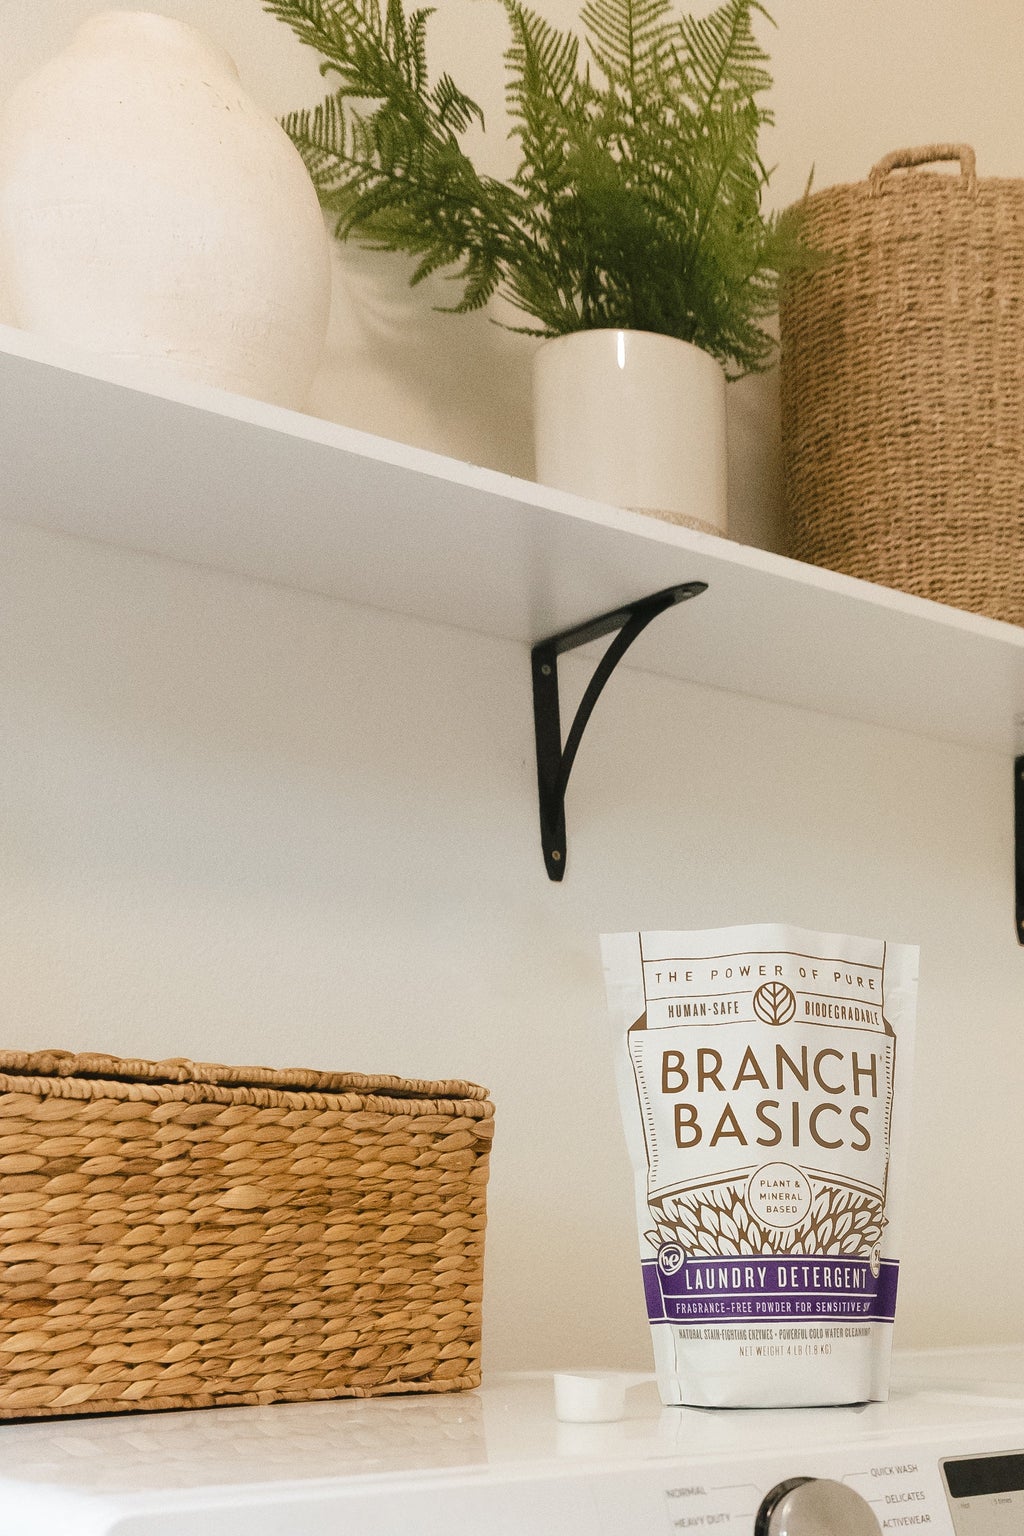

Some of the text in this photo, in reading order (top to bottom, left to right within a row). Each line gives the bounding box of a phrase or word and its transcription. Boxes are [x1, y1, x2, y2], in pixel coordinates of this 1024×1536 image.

[655, 965, 875, 991] THE POWER OF PURE
[668, 1001, 739, 1018] HUMAN-SAFE
[805, 1001, 880, 1026] BIODEGRADABLE
[661, 1044, 878, 1098] BRANCH
[674, 1100, 871, 1151] BASICS
[760, 1180, 790, 1188] PLANT
[760, 1193, 803, 1201] MINERAL
[685, 1266, 867, 1290] LAUNDRY DETERGENT
[676, 1302, 752, 1314] FRAGRANCE-FREE
[756, 1302, 792, 1313] POWDER
[795, 1302, 812, 1312] FOR
[816, 1302, 862, 1312] SENSITIVE
[679, 1329, 703, 1340] NATURAL
[779, 1329, 808, 1340] POWERFUL
[809, 1328, 823, 1339] COLD
[825, 1328, 843, 1338] WATER
[740, 1346, 753, 1356] NET
[756, 1345, 784, 1356] WEIGHT
[794, 1345, 803, 1355] LB
[871, 1464, 918, 1477] QUICK WASH
[885, 1491, 926, 1504] DELICATES
[706, 1513, 730, 1525] DUTY
[883, 1514, 931, 1528] ACTIVEWEAR
